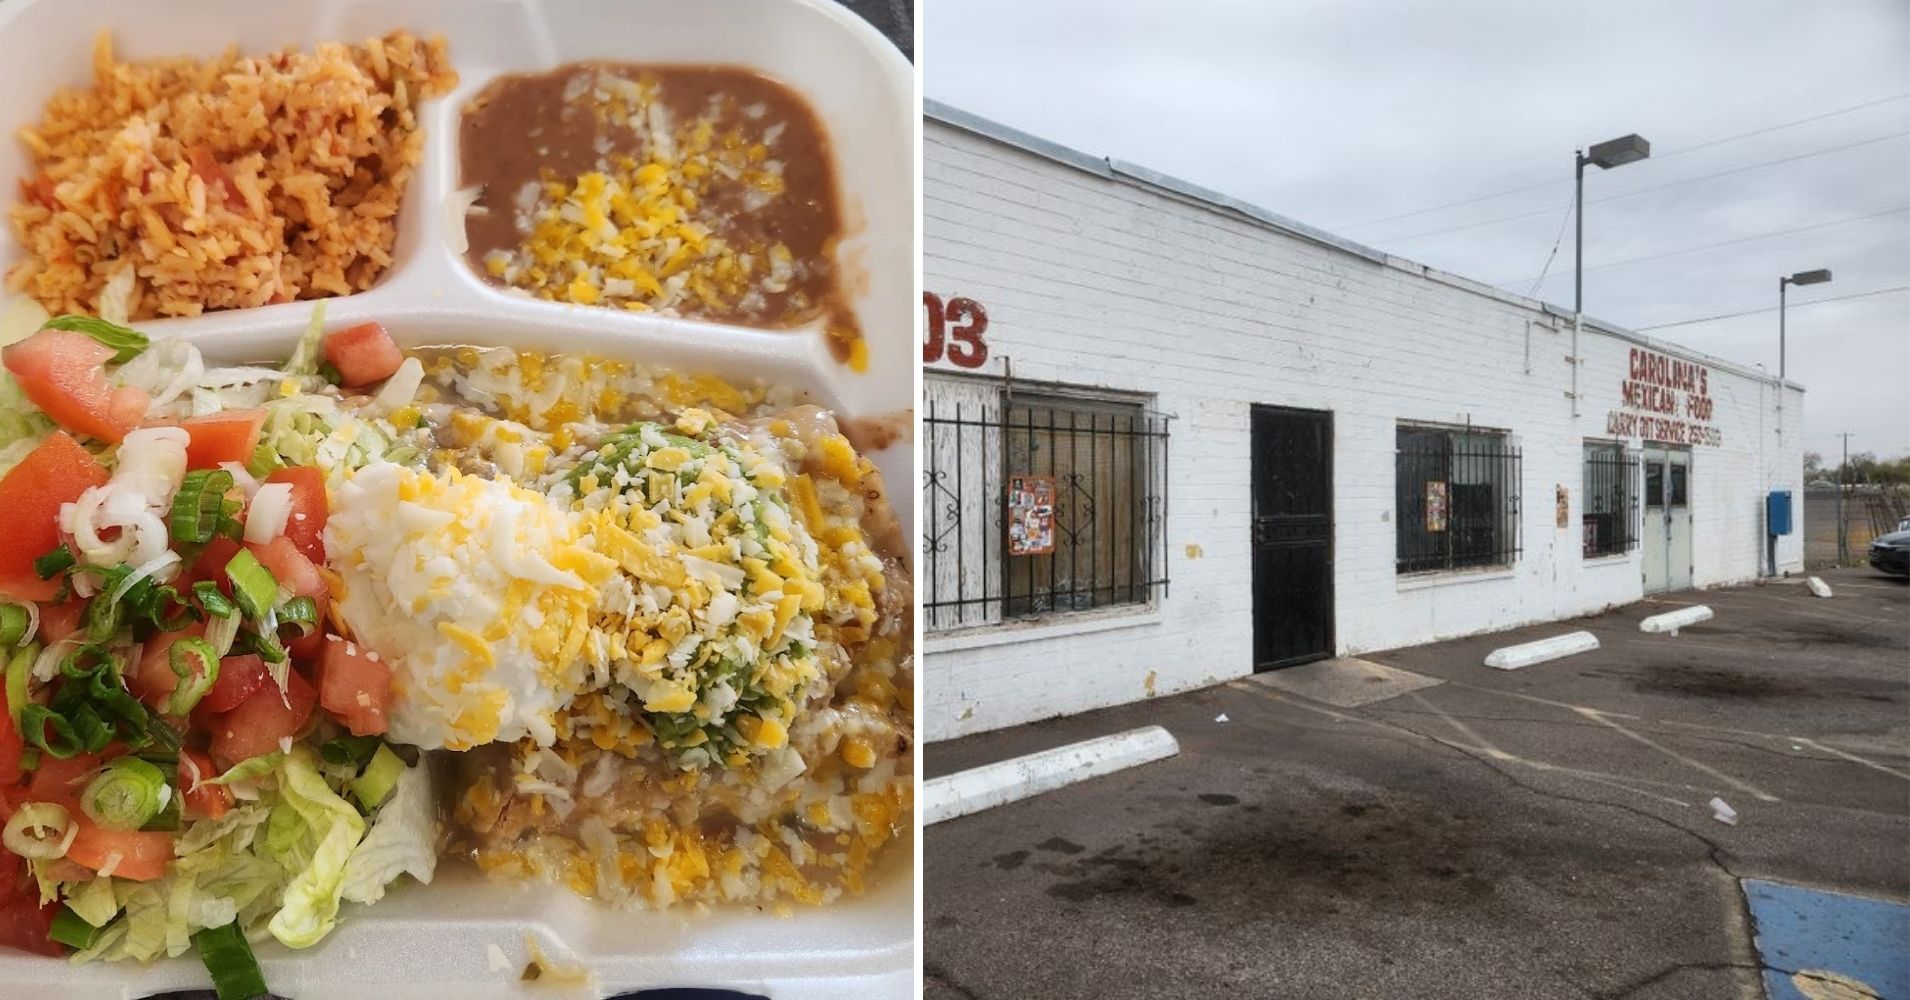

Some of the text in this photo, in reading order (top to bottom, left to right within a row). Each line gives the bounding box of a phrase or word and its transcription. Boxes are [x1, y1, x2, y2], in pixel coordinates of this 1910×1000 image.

[1629, 347, 1708, 395] CAROLINA'S
[1621, 379, 1713, 421] MEXICAN FOOD
